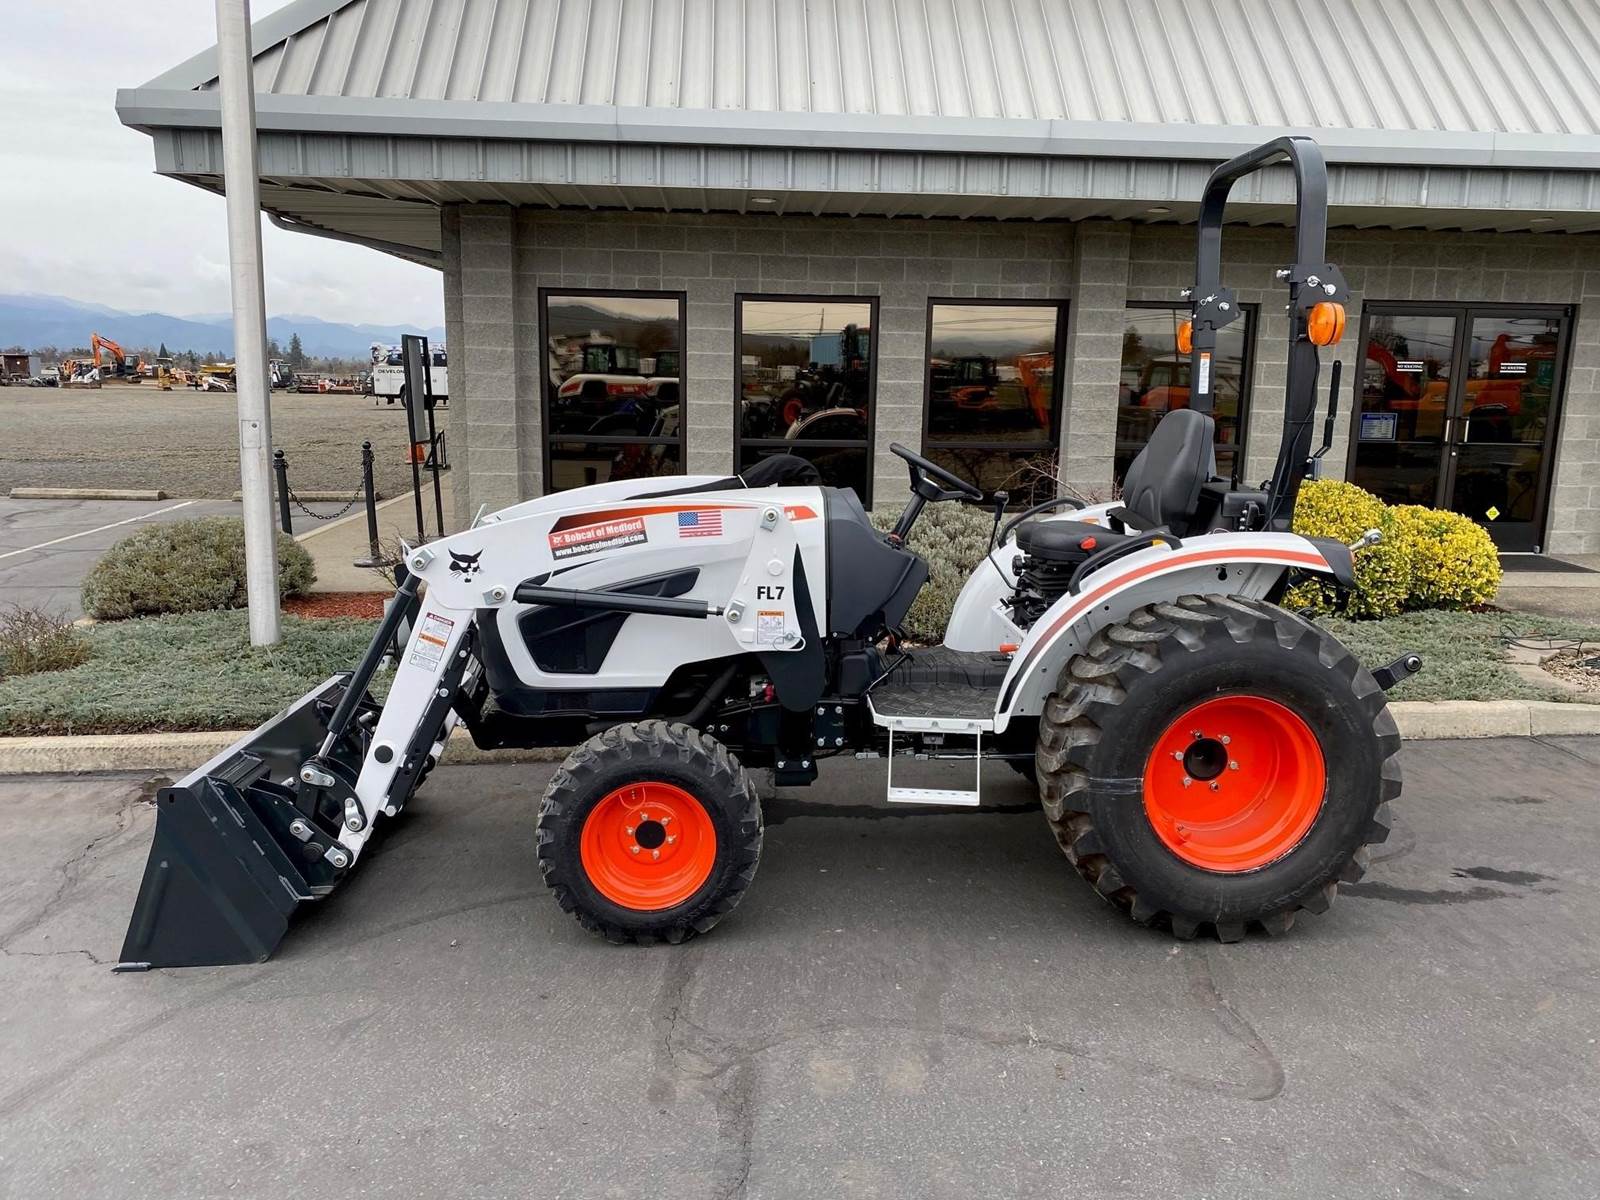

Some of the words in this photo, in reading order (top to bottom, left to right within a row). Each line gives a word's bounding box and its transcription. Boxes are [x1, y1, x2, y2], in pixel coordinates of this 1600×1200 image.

[564, 528, 596, 544] Bobcat
[596, 527, 605, 538] of
[606, 520, 642, 536] Medford
[555, 533, 645, 558] www.bobcatofmedford.com
[757, 586, 785, 600] FL7
